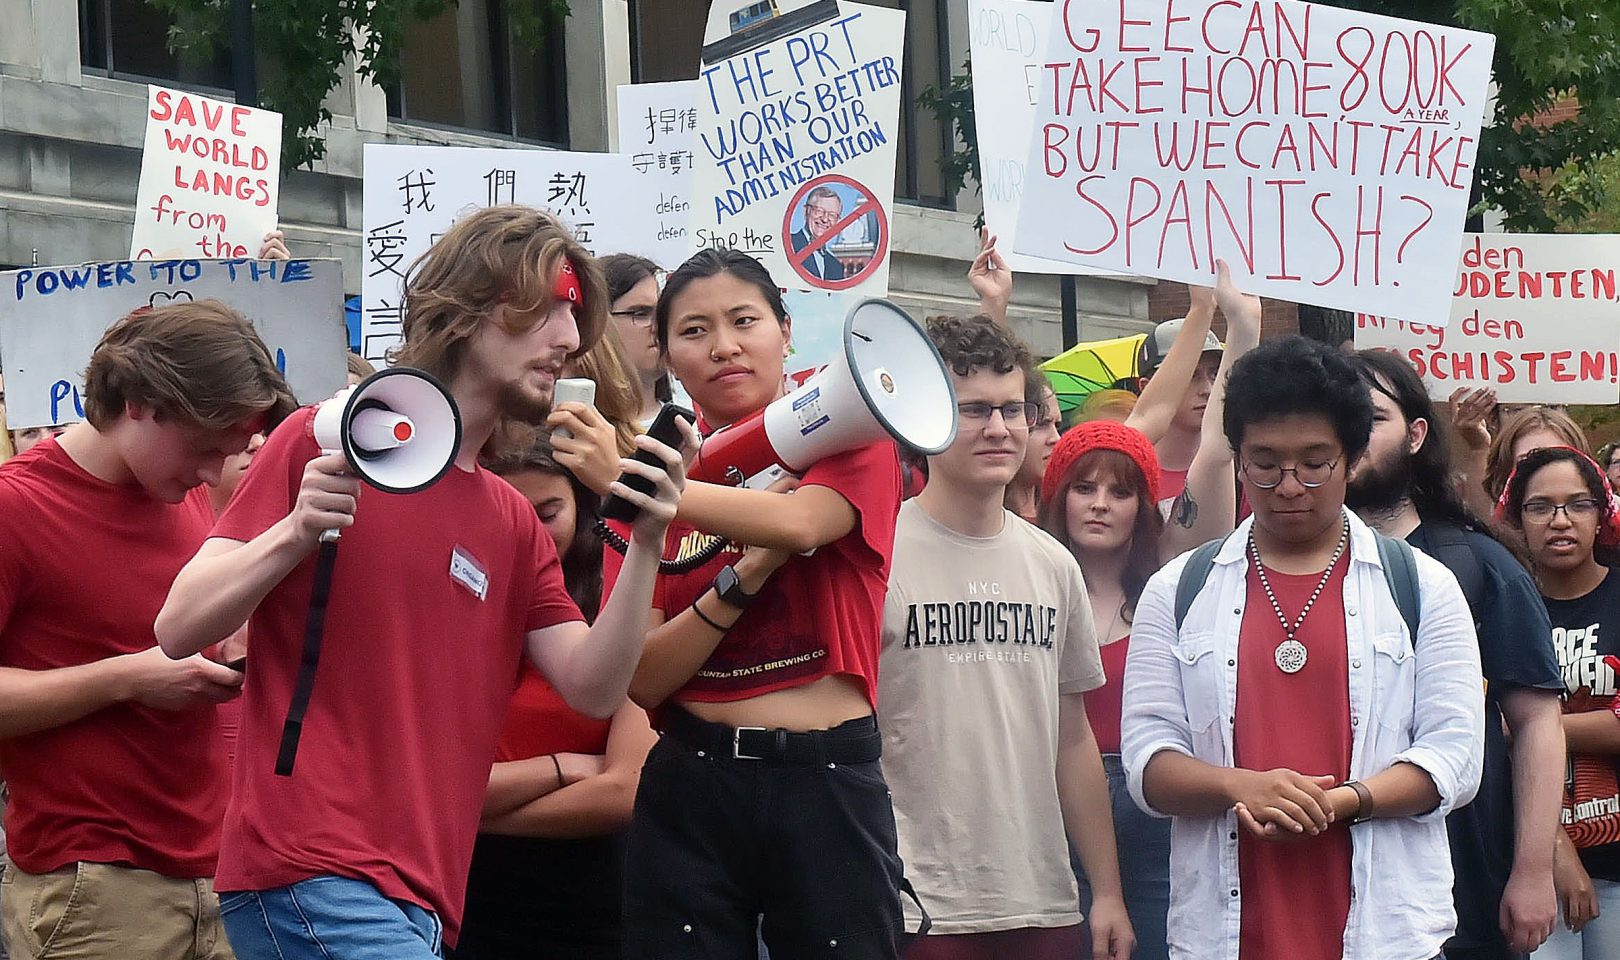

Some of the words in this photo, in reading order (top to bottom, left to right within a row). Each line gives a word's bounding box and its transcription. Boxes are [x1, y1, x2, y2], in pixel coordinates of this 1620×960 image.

[1201, 1, 1311, 60] CAN
[701, 49, 782, 115] THE
[786, 12, 862, 86] PRT
[1044, 57, 1164, 116] TAKE
[1181, 55, 1333, 118] HOME
[1336, 26, 1472, 114] 800K
[150, 91, 251, 137] SAVE
[700, 91, 811, 160] WORKS
[815, 56, 900, 114] BETTER
[1404, 108, 1414, 119] A
[164, 129, 269, 172] WORLD
[717, 132, 795, 185] THAN
[808, 99, 870, 145] OUR
[1043, 121, 1139, 177] BUT
[1155, 119, 1231, 171] WE
[1235, 114, 1374, 176] CAN'T
[1380, 124, 1474, 190] TAKE
[175, 166, 270, 207] LANGS
[714, 121, 887, 224] ADMINISTRATION
[151, 195, 226, 233] from
[1063, 174, 1434, 287] SPANISH?
[198, 235, 248, 258] the
[695, 228, 738, 250] Stop
[742, 226, 774, 250] the
[1463, 235, 1524, 269] den
[15, 261, 136, 301] POWER
[218, 259, 314, 283] THE
[1462, 309, 1524, 340] den
[1372, 346, 1618, 385] SCHISTEN!
[968, 582, 1001, 596] NYC
[732, 664, 763, 678] STATE
[764, 654, 811, 671] BREWING
[948, 651, 994, 664] EMPIRE
[996, 651, 1031, 664] STATE
